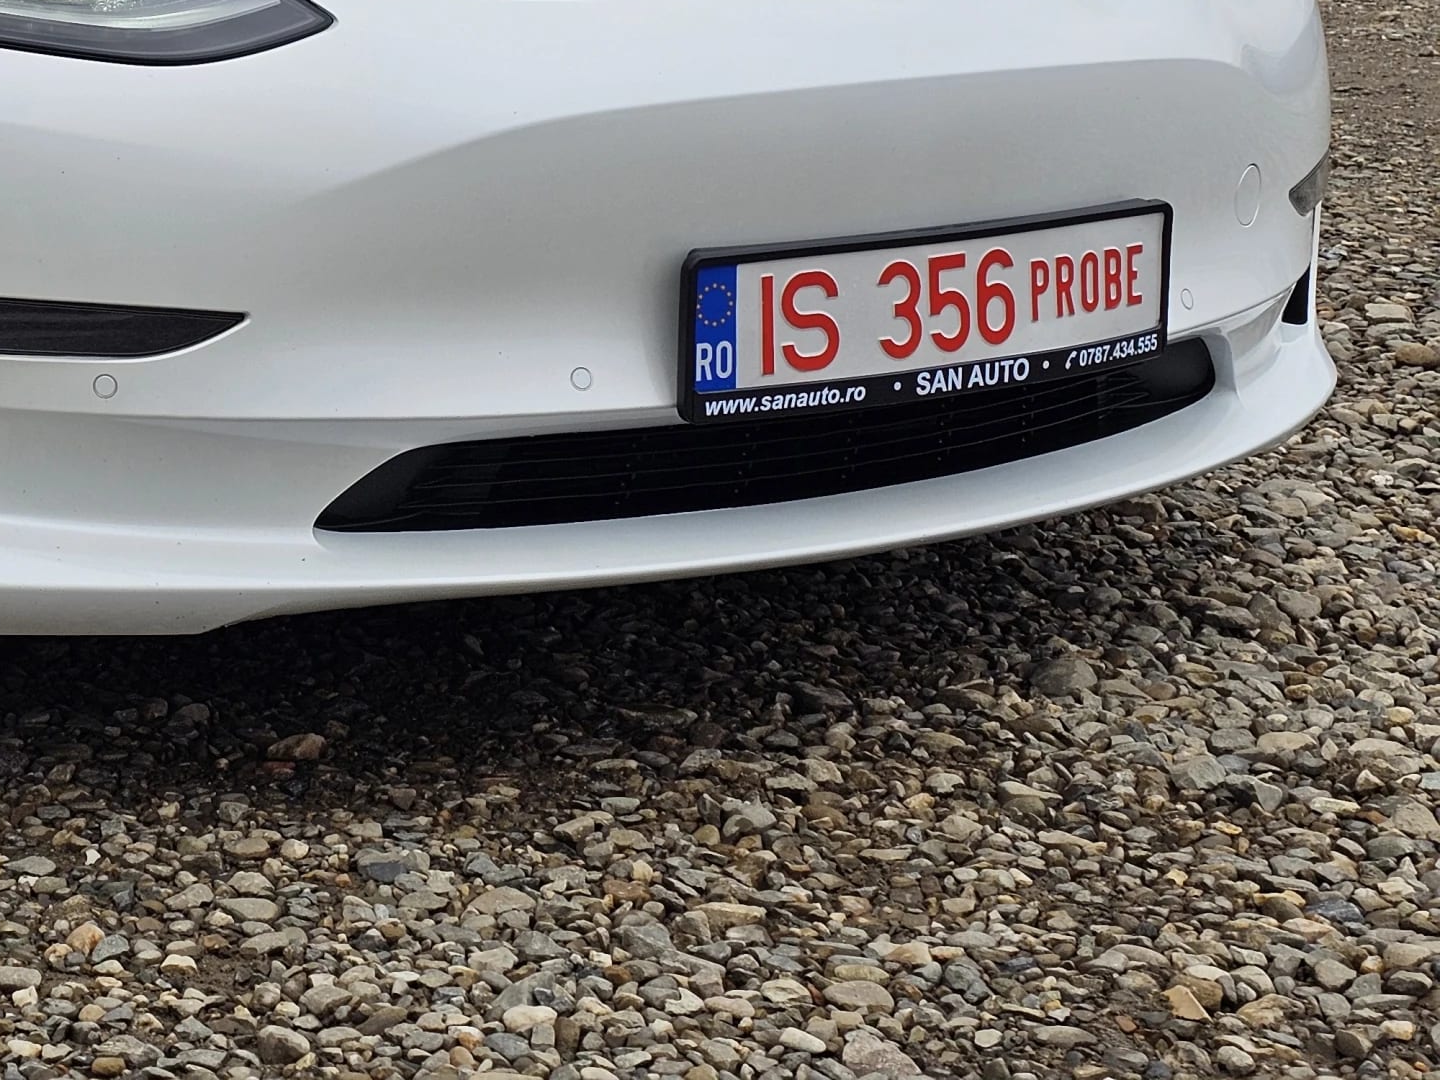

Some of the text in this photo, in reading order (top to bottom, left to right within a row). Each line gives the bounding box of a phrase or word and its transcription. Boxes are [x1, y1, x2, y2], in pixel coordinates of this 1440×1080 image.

[760, 243, 1144, 376] IS 356 PROBE
[695, 341, 733, 382] RO
[705, 333, 1158, 416] www.sanauto.ro SAN AUTO 0787.434.555
